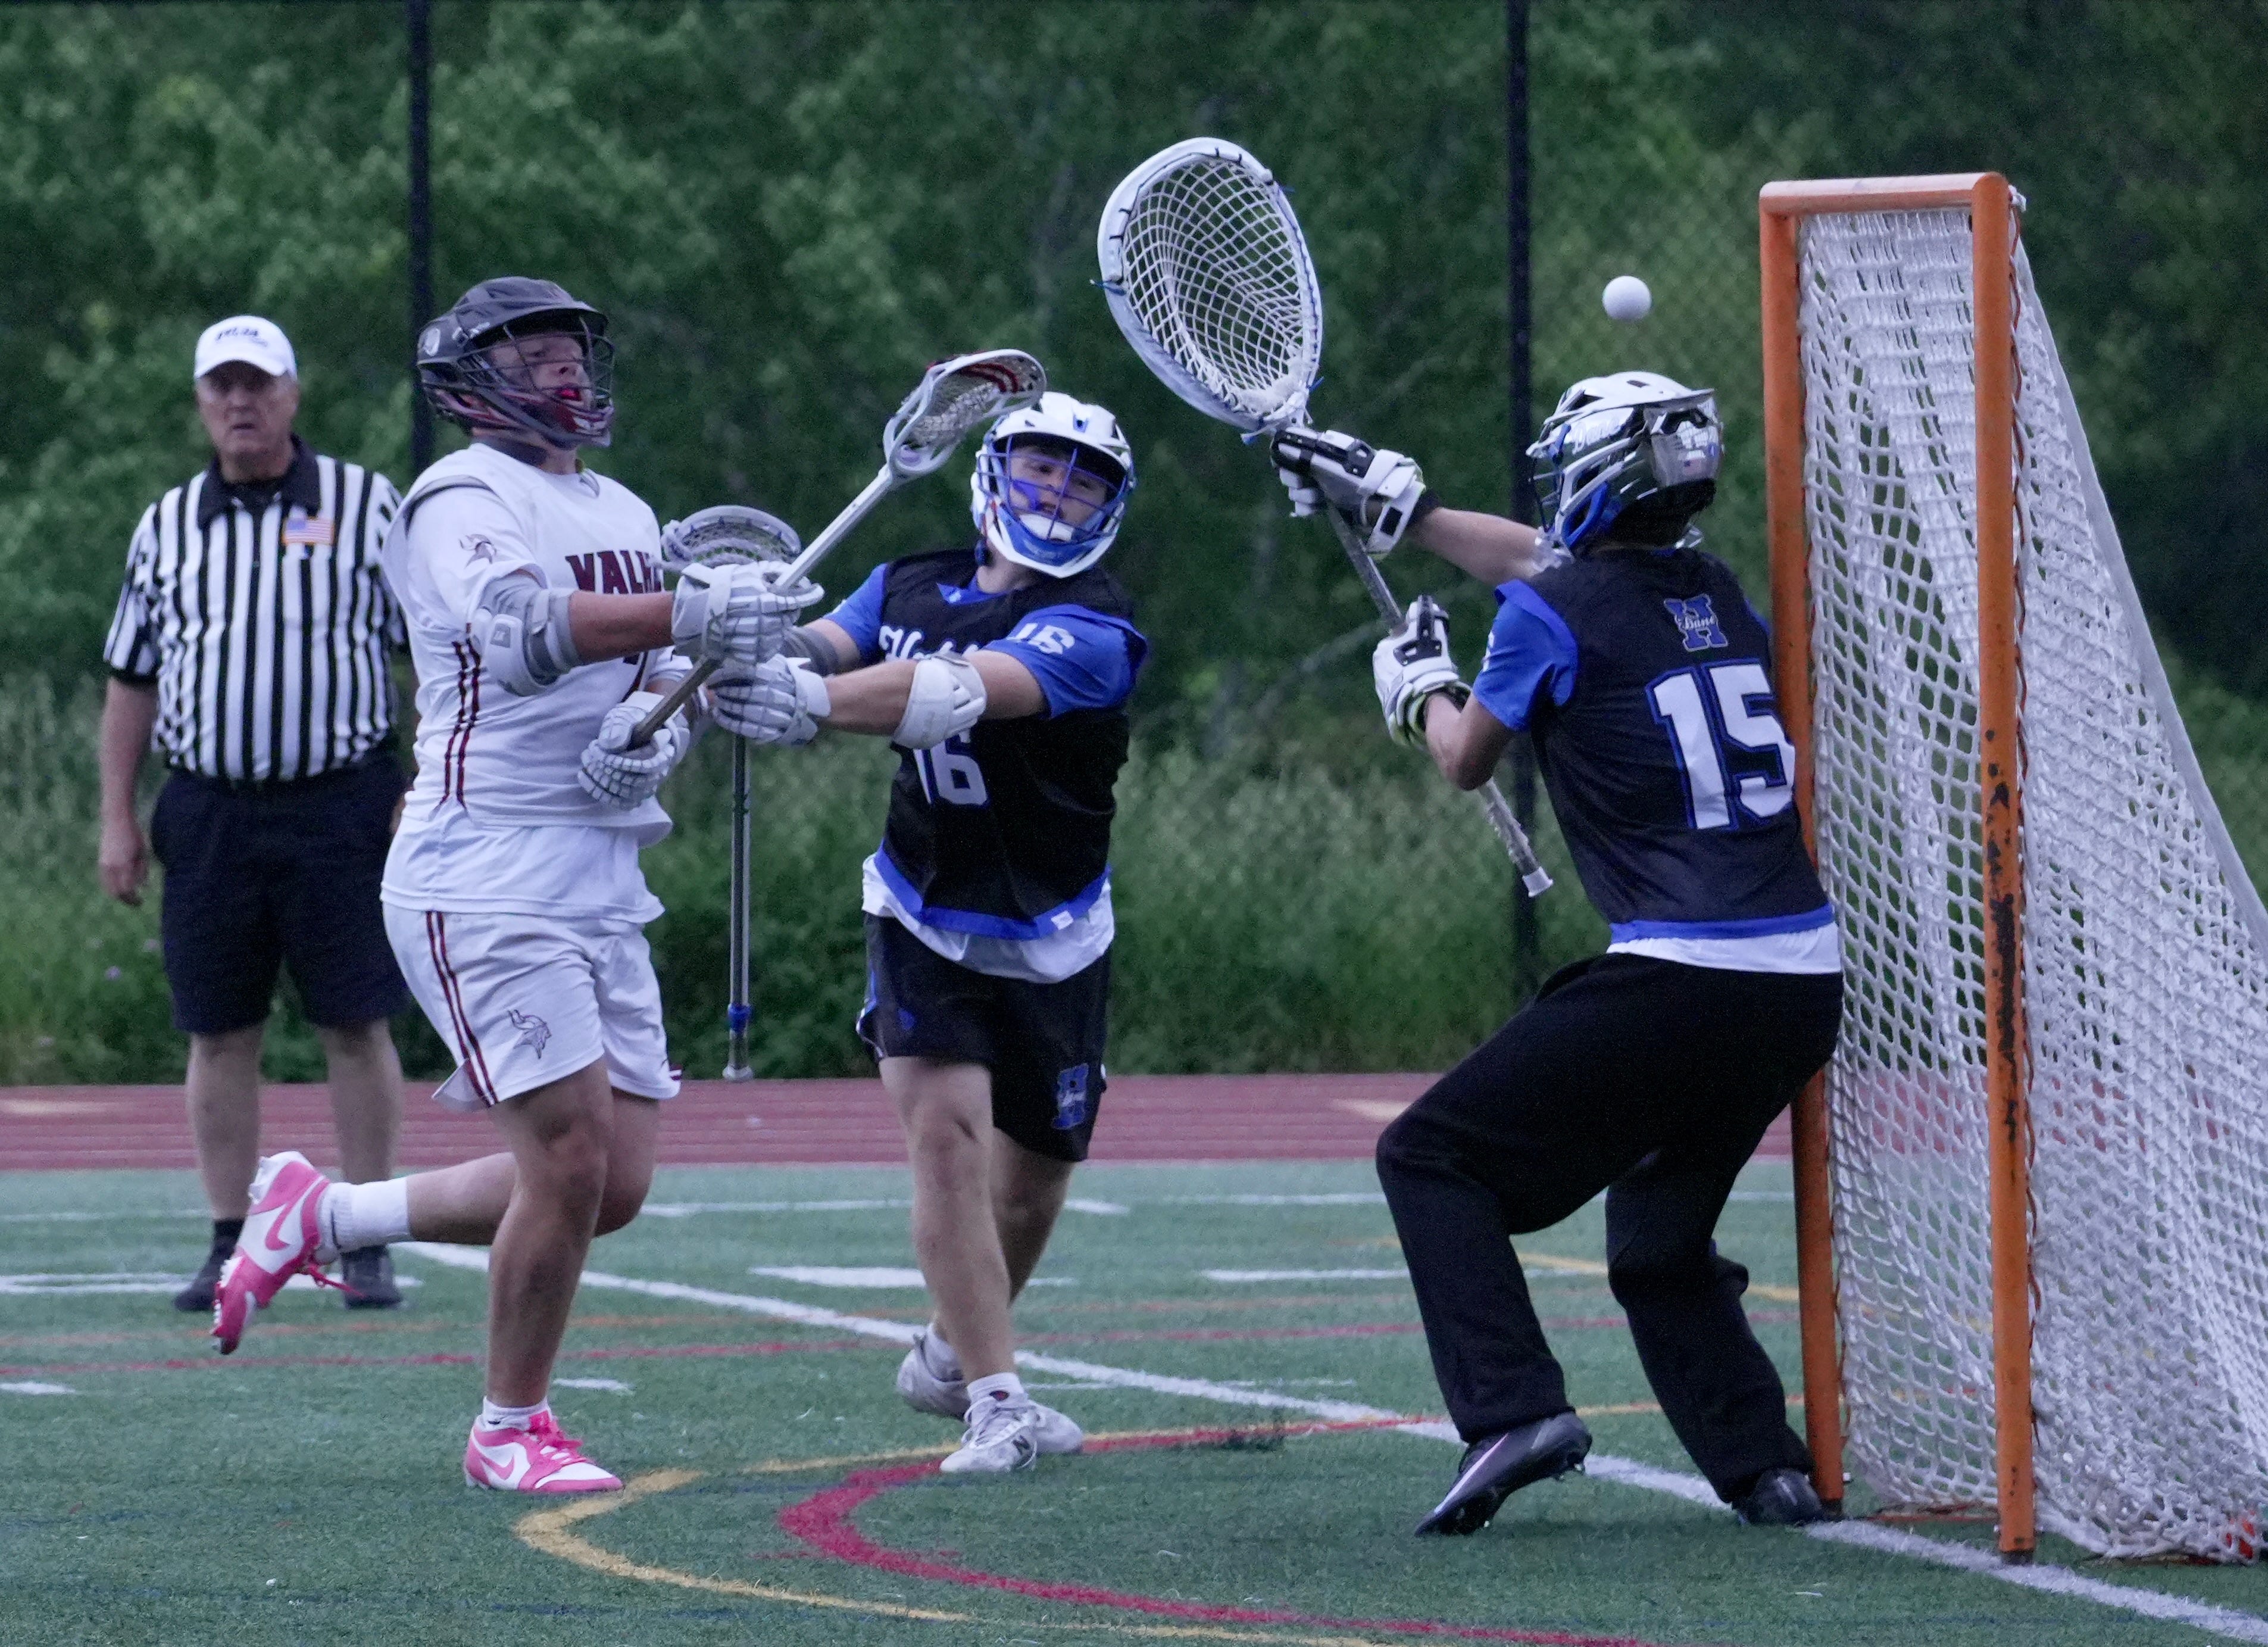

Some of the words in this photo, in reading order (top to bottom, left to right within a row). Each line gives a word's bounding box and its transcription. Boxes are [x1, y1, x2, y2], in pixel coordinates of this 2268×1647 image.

[565, 550, 661, 594] VALH
[1006, 623, 1076, 654] 16
[913, 728, 988, 806] 16
[1654, 663, 1795, 829] 15
